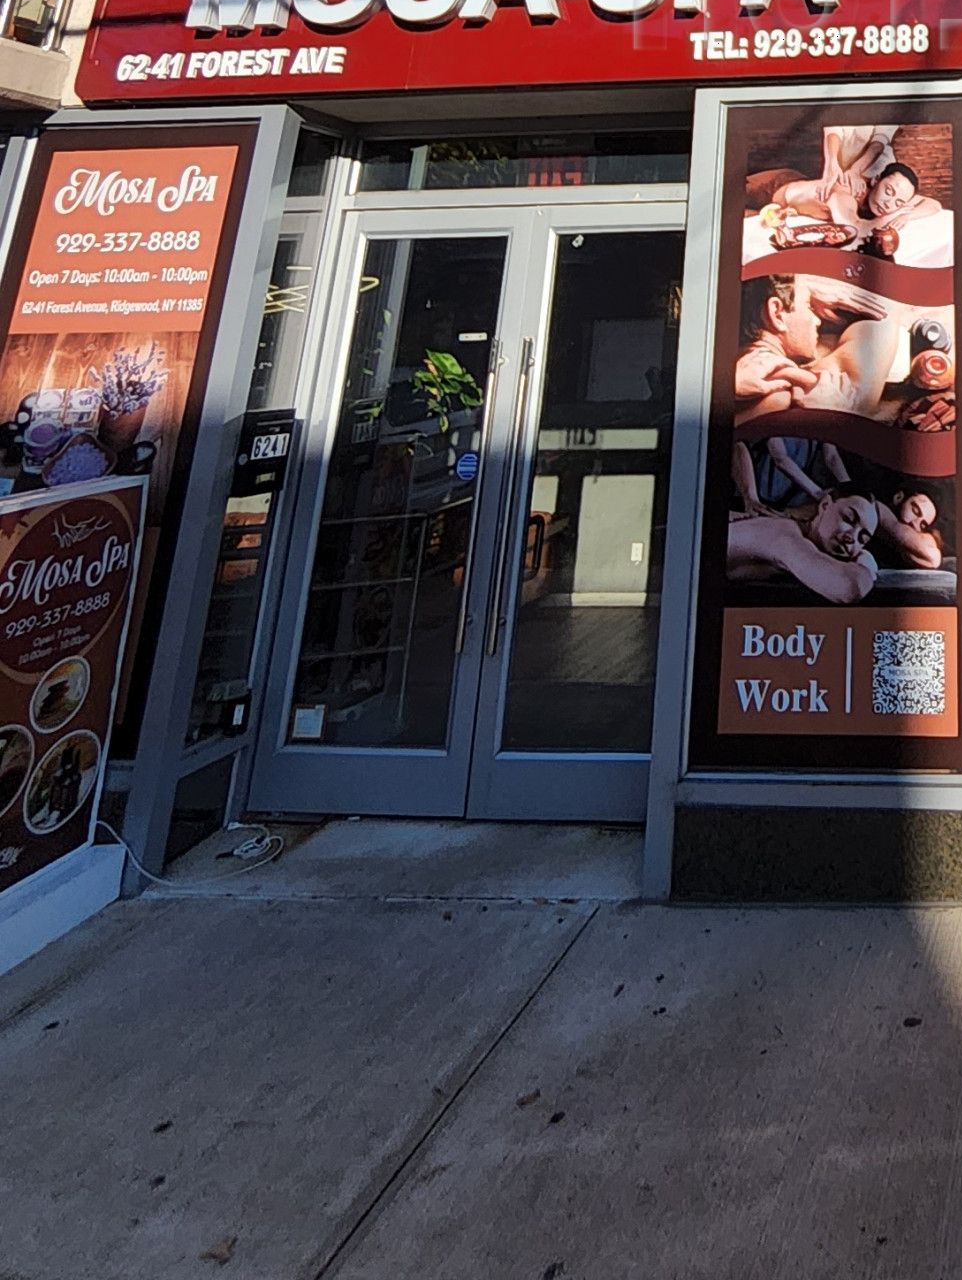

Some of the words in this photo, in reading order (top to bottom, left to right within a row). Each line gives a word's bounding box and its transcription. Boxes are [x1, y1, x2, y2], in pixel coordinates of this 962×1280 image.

[690, 31, 748, 60] TEL:
[753, 24, 929, 58] 929-337-8888
[116, 53, 185, 81] 62-41
[186, 48, 290, 78] FOREST
[289, 46, 347, 75] AVE
[56, 230, 201, 254] 929-337-8888
[29, 270, 58, 287] Open
[61, 269, 70, 284] 7
[104, 268, 149, 284] 10:00am
[161, 267, 208, 285] 10:00pm
[46, 300, 74, 313] Forest
[162, 298, 177, 311] NY
[254, 435, 287, 457] 6241
[6, 592, 111, 639] 929-337-8888
[741, 625, 826, 665] Body
[735, 679, 829, 713] Work
